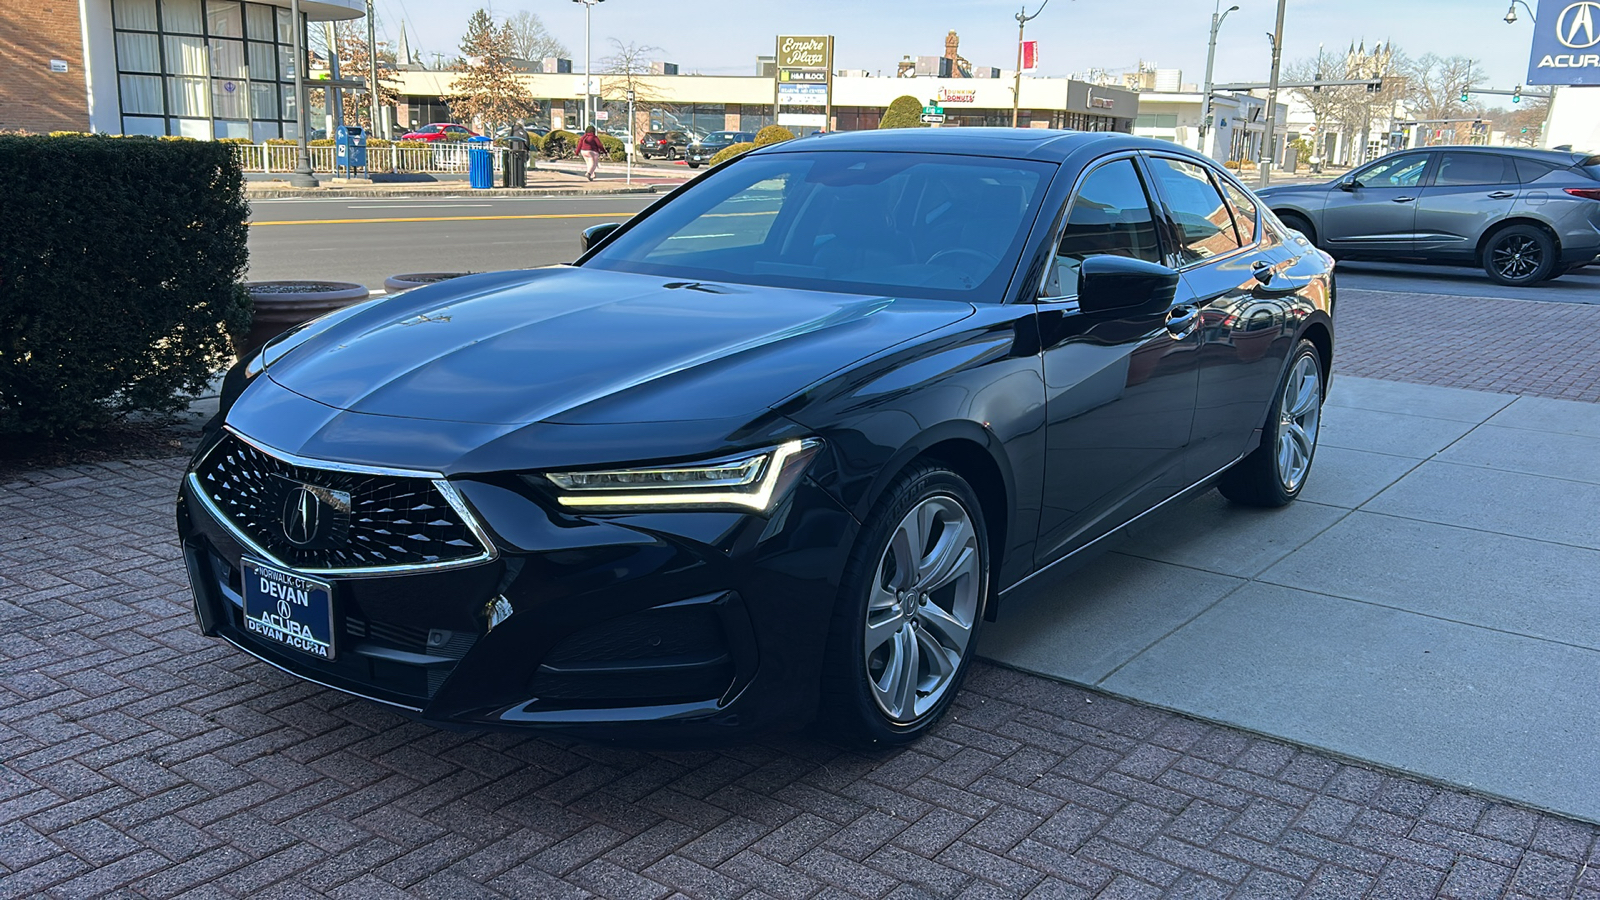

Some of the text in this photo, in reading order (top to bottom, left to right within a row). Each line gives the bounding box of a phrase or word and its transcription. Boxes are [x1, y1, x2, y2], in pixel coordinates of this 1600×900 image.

[782, 37, 824, 53] Empire
[786, 50, 823, 66] Plaza
[1537, 54, 1600, 68] ACUR
[295, 578, 306, 589] CT
[260, 577, 309, 607] DEVAN
[261, 610, 314, 641] ACURA
[248, 620, 328, 657] DEVAN ACURA
